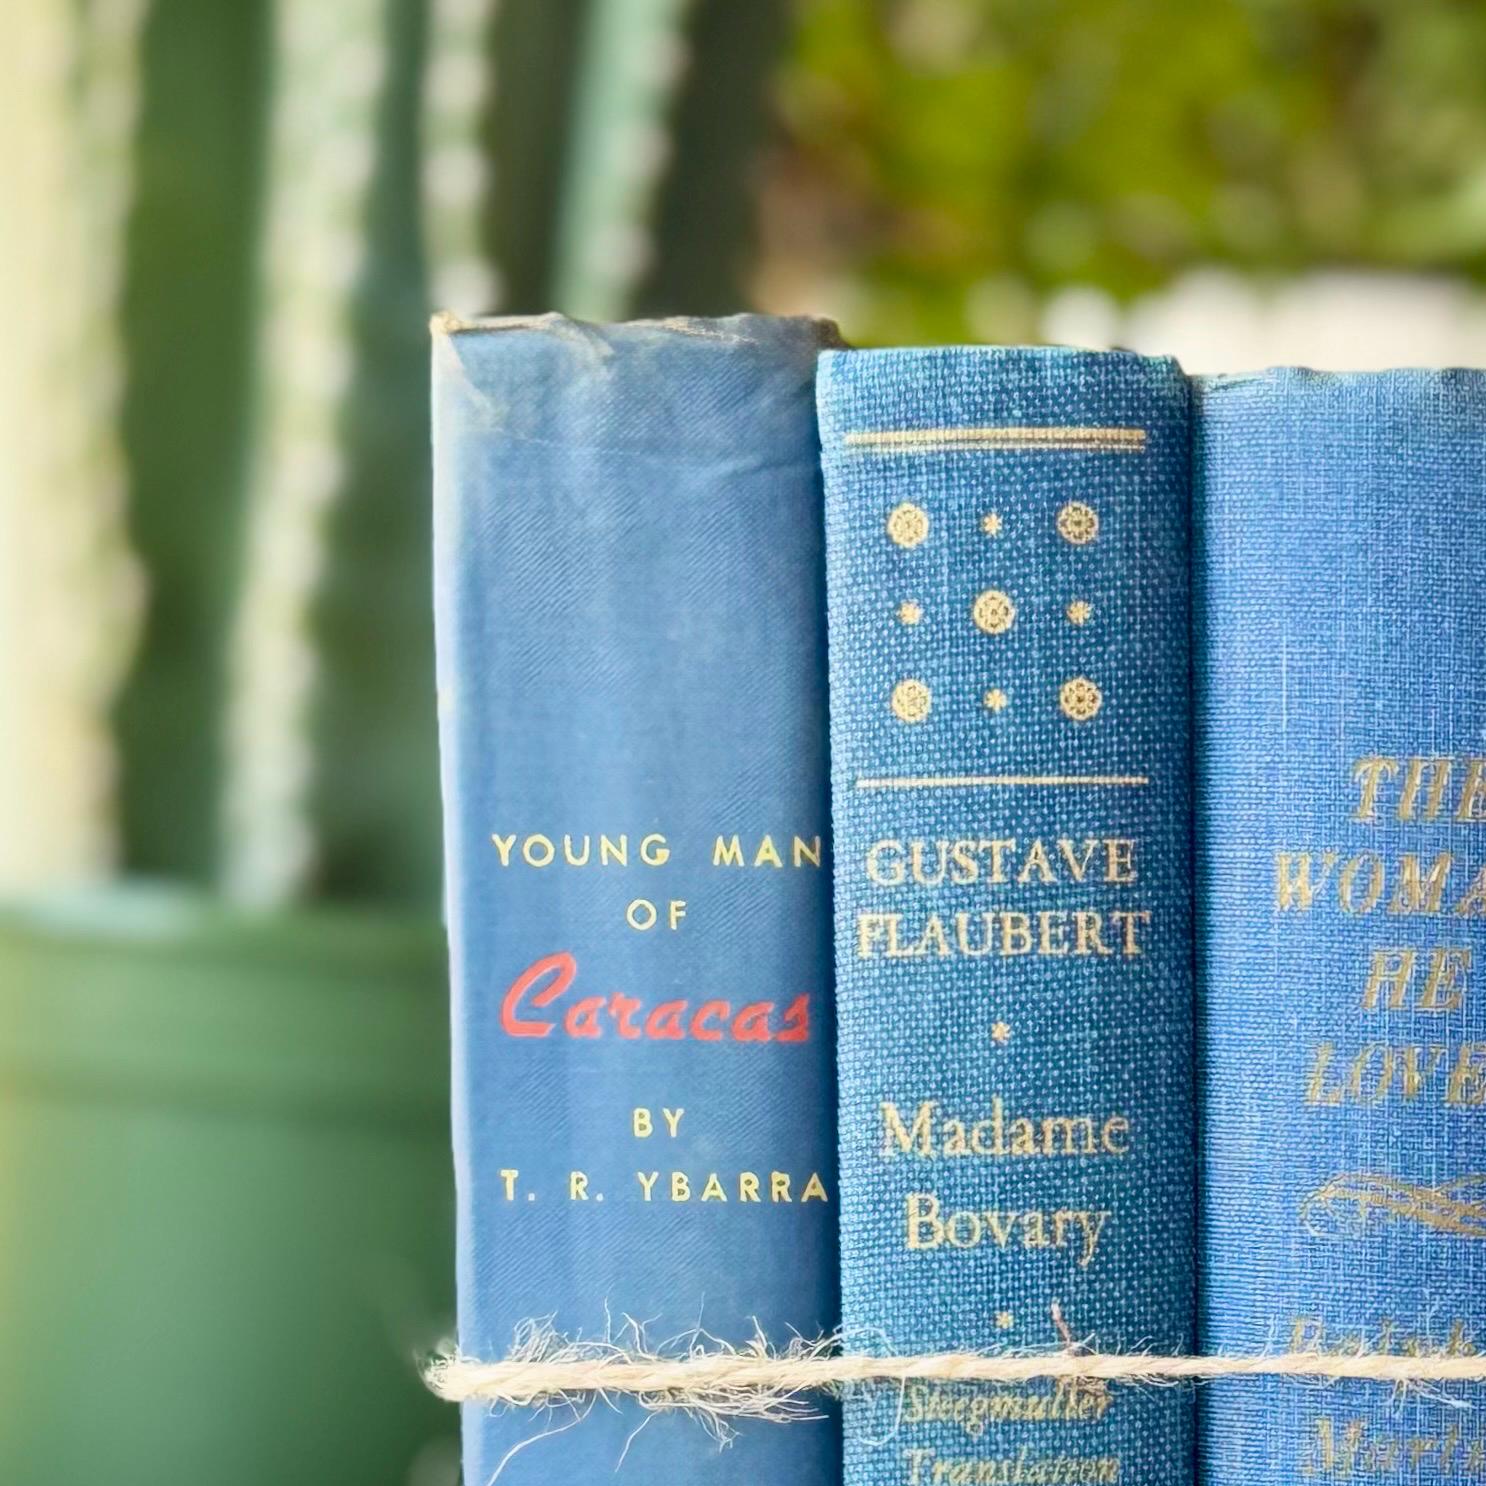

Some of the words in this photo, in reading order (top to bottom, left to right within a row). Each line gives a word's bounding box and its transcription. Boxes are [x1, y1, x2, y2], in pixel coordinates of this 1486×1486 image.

[491, 833, 671, 868] YOUNG
[711, 834, 822, 868] MAN
[866, 838, 1137, 886] GUSTAVE
[625, 898, 687, 931] OF
[856, 909, 1152, 959] FLAUBERT
[500, 949, 811, 1044] Caracas
[1360, 946, 1473, 1011] HE
[632, 1107, 686, 1138] BY
[879, 1094, 1131, 1158] Madame
[499, 1169, 536, 1202] T.
[569, 1170, 605, 1202] R.
[637, 1171, 830, 1203] YBARRA
[905, 1191, 1112, 1269] Bovary
